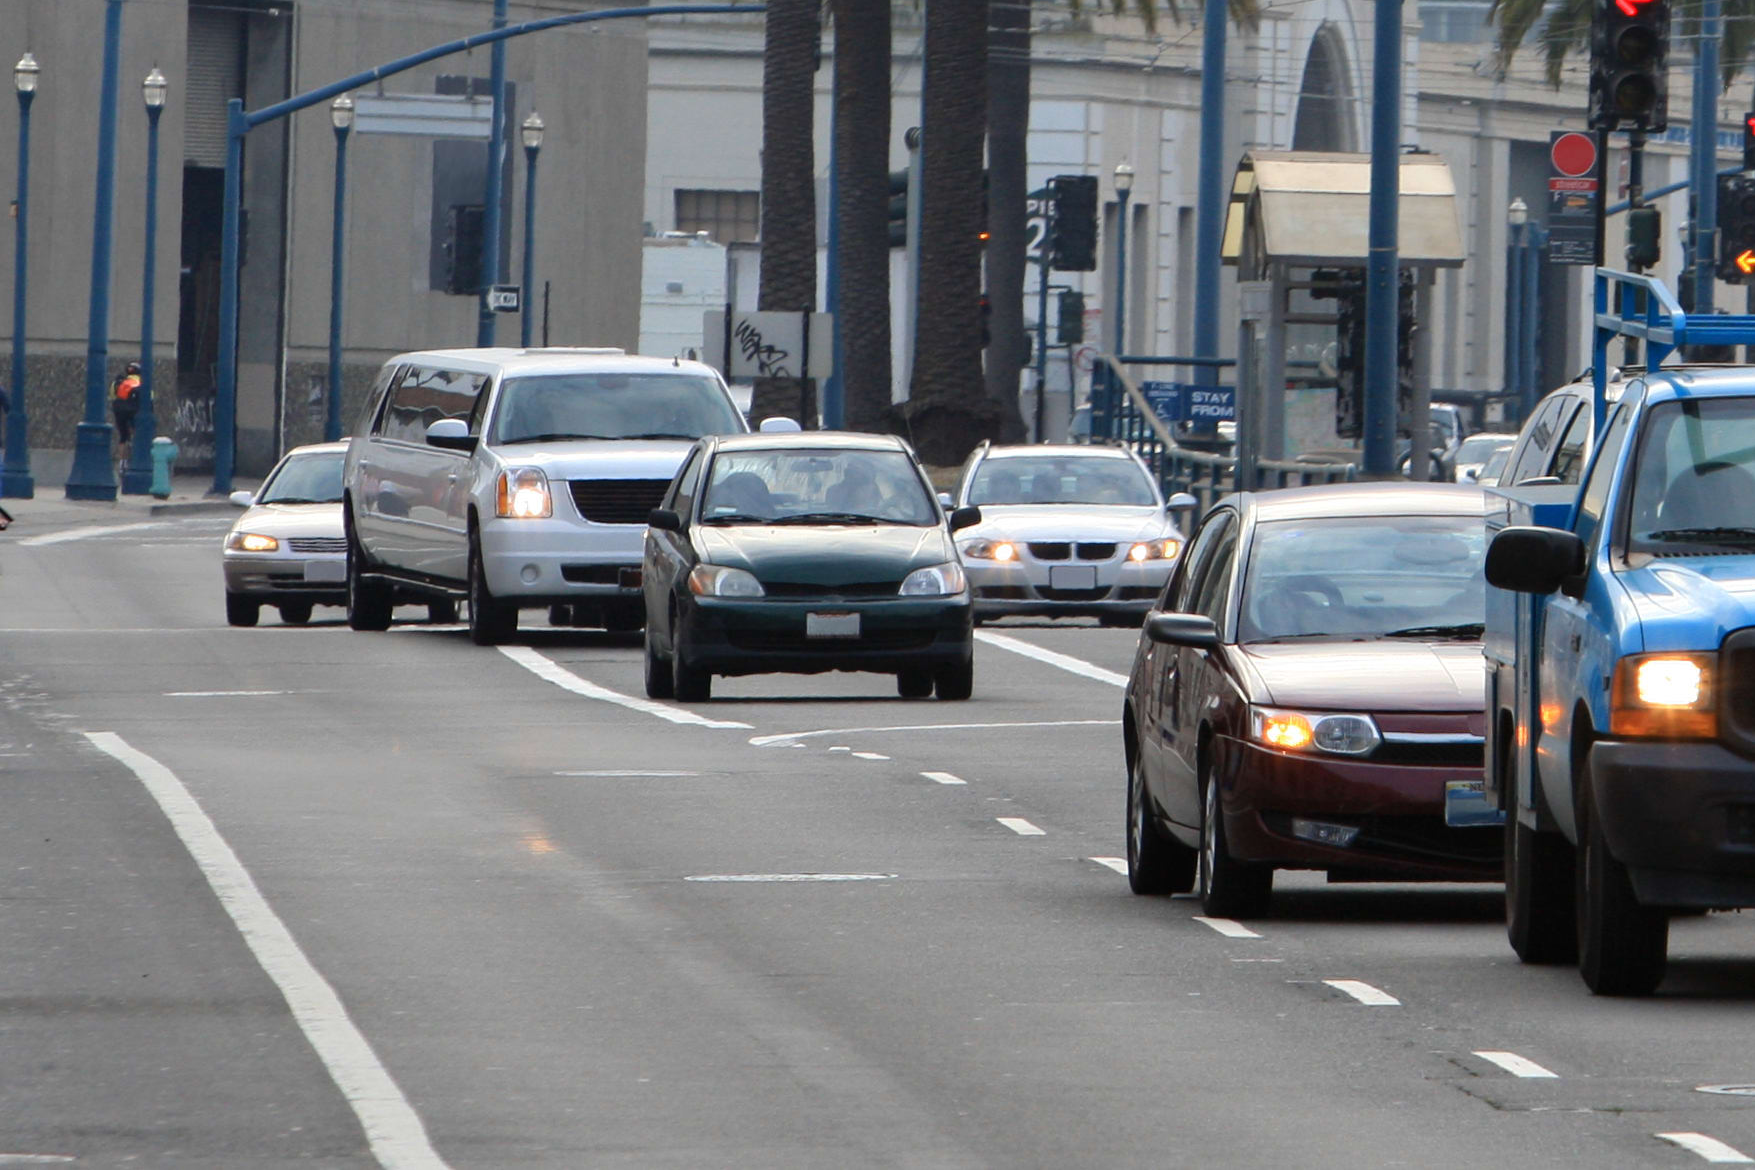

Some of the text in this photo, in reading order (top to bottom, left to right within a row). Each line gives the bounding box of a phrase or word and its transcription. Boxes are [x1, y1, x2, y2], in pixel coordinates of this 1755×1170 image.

[1026, 199, 1056, 216] PIE
[1192, 391, 1231, 404] STAY
[1191, 404, 1234, 417] FROM
